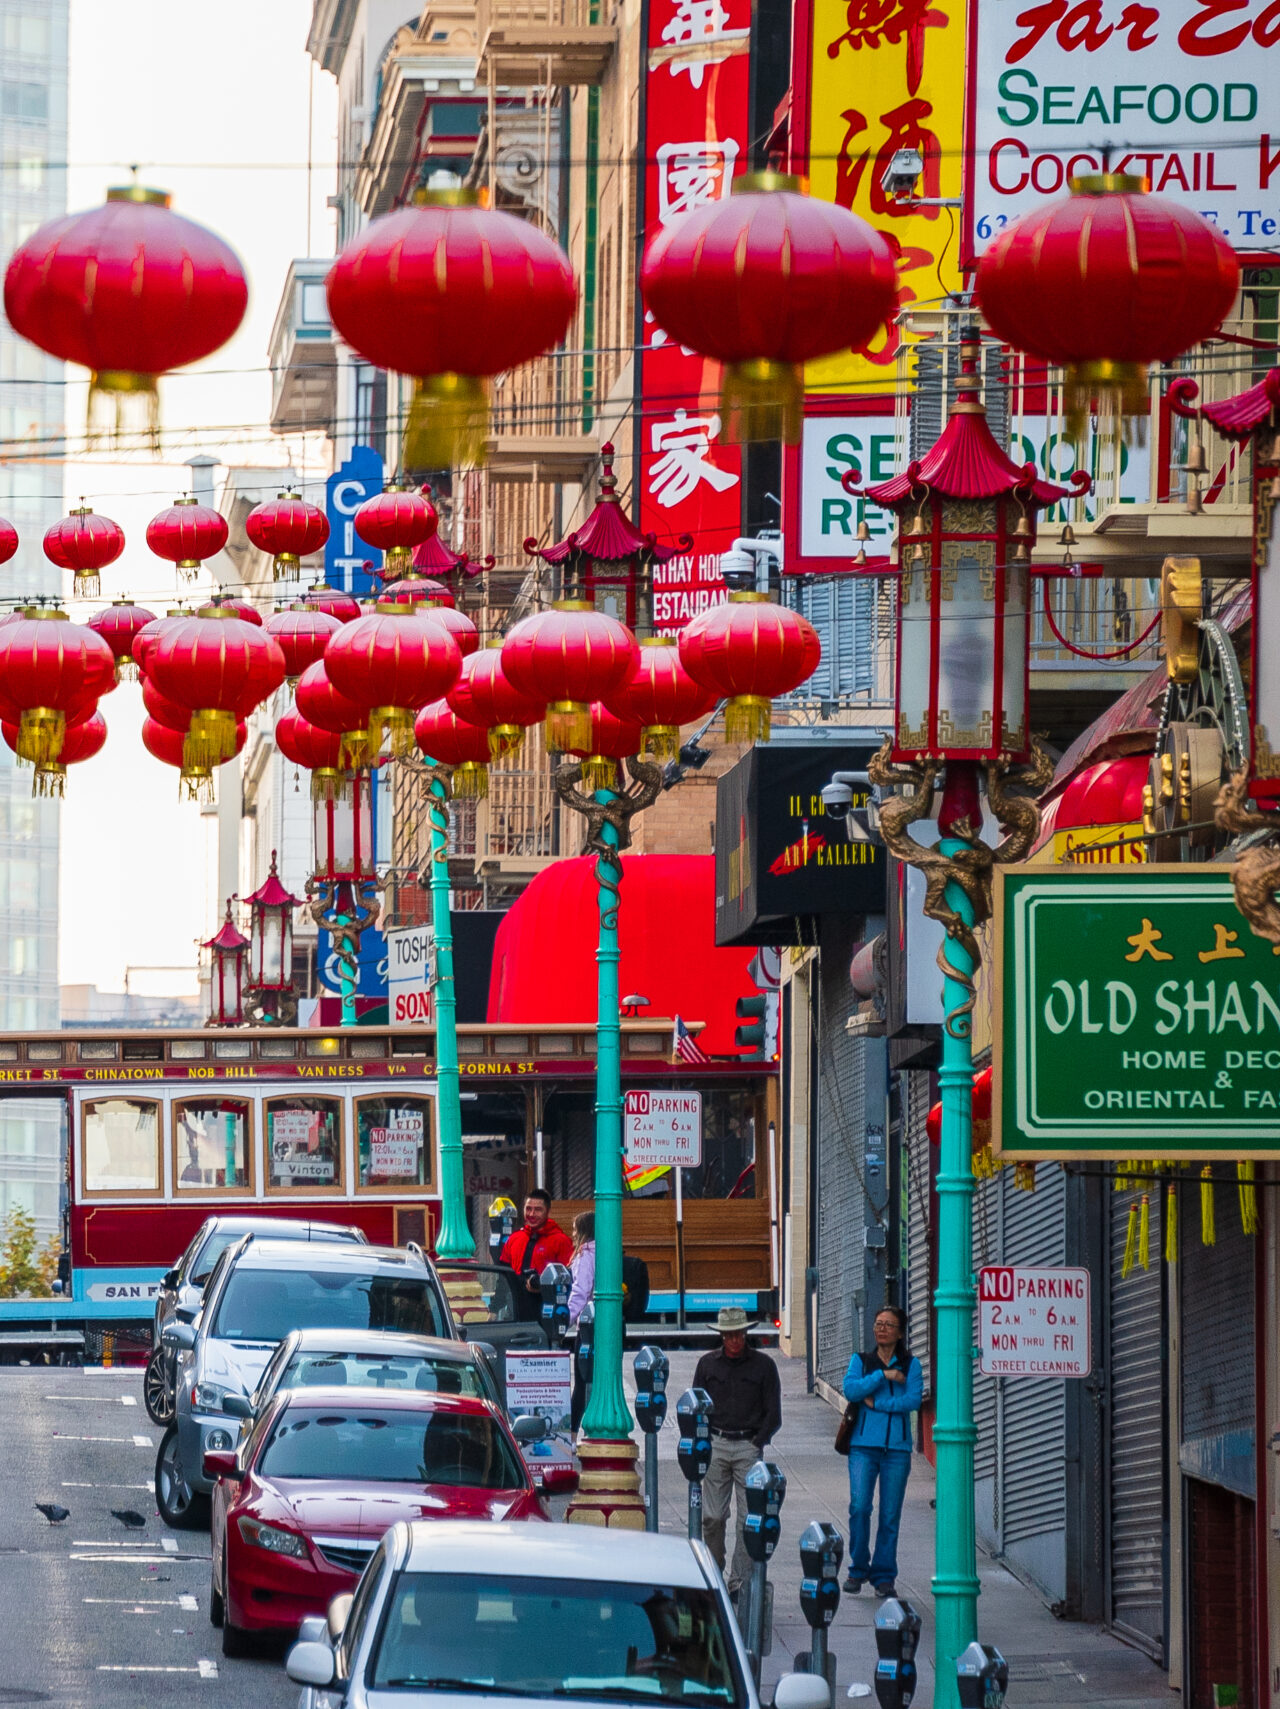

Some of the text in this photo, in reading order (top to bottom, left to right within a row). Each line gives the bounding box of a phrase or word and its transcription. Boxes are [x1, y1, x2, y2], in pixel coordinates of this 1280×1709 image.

[997, 68, 1258, 126] SEAFOOD
[988, 137, 1237, 194] COCKTAIL
[1238, 210, 1280, 236] Te
[333, 480, 367, 593] CIT
[653, 552, 724, 585] ATHAY HOU
[654, 588, 730, 621] ESTAURAN
[784, 843, 876, 867] ART GALLERY
[1125, 918, 1280, 964] 大上
[395, 991, 431, 1021] SON
[1044, 979, 1137, 1034] OLD
[1122, 1051, 1206, 1069] HOME
[85, 1068, 165, 1080] CHINATOWN
[188, 1067, 215, 1079] NOB
[225, 1066, 258, 1079] HILL
[298, 1066, 324, 1077] VAN
[329, 1065, 364, 1077] NESS
[423, 1063, 512, 1075] CFORNIA
[1215, 1071, 1233, 1089] &
[628, 1094, 697, 1113] NO PARKING
[1084, 1090, 1225, 1109] ORIENTAL
[372, 1130, 416, 1143] NO PARKING
[634, 1137, 651, 1149] MON
[676, 1137, 690, 1149] FRI
[633, 1155, 694, 1163] STREET CLEANING
[289, 1165, 329, 1175] Vinton
[105, 1286, 140, 1298] SAN
[983, 1271, 1084, 1299] NO PARKING
[991, 1305, 1002, 1325] 2
[1029, 1308, 1037, 1316] TO
[1047, 1306, 1057, 1325] 6
[991, 1334, 1074, 1351] MON THRU FRI
[991, 1361, 1080, 1372] STREET CLEANING
